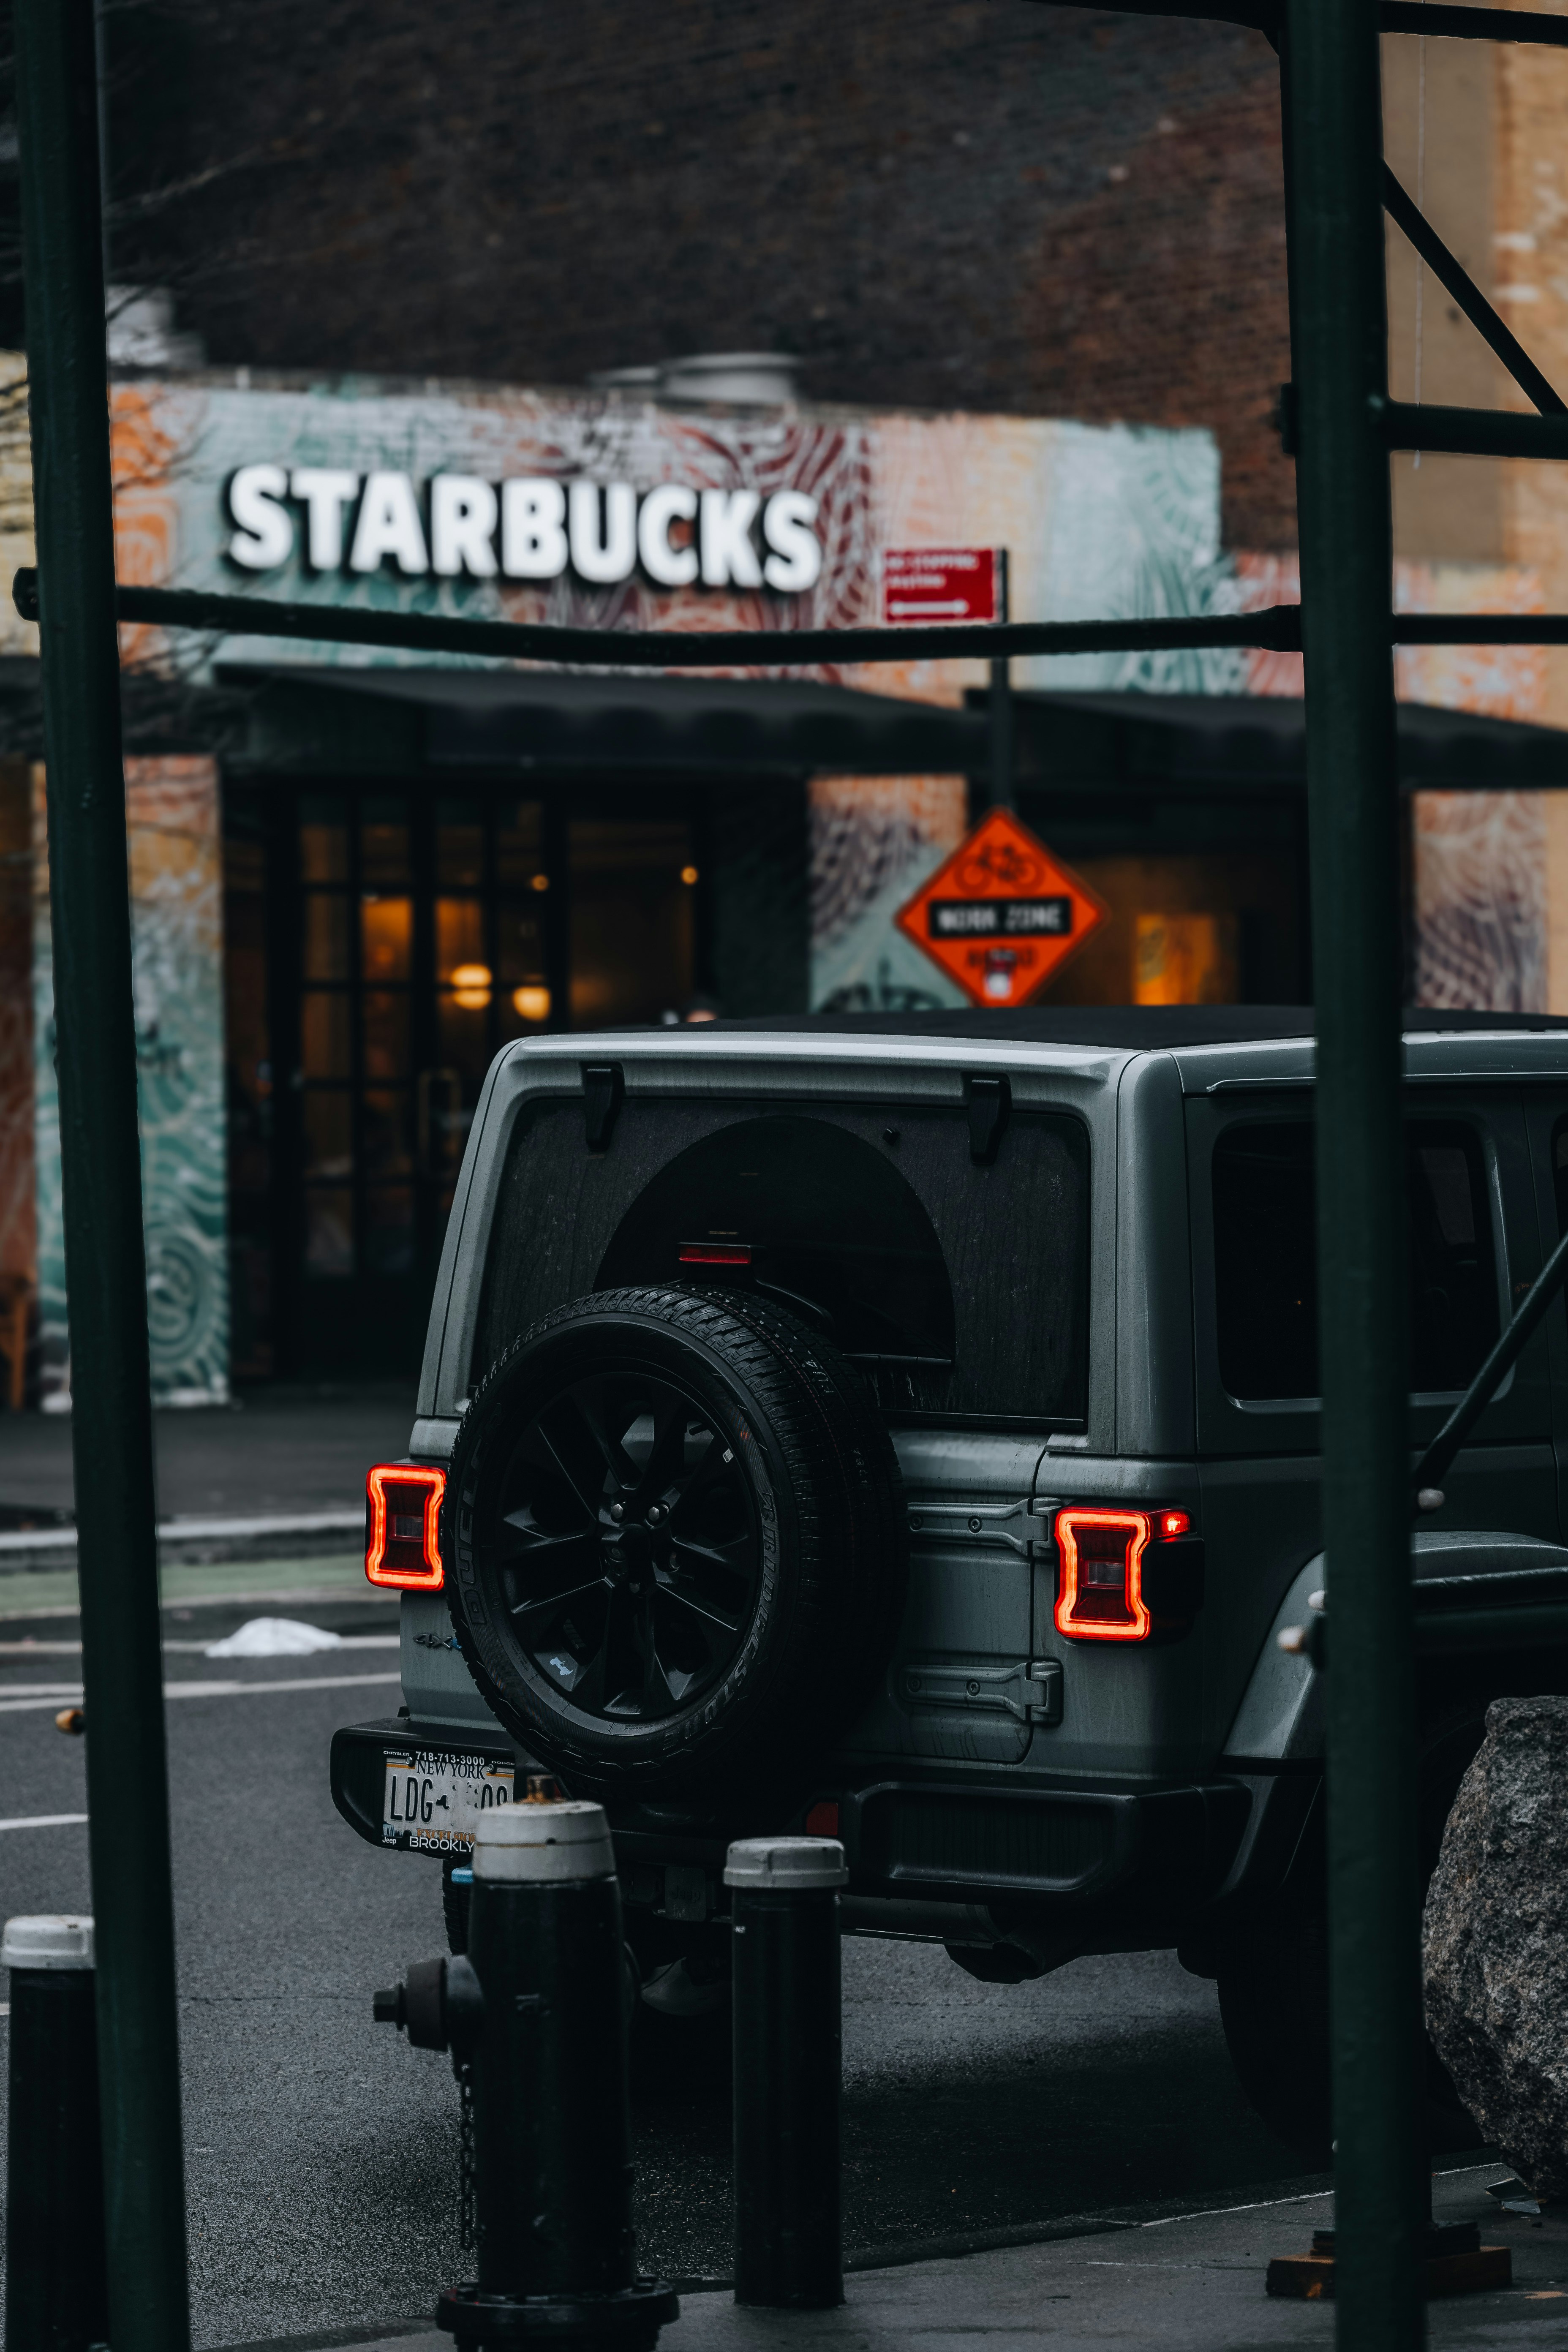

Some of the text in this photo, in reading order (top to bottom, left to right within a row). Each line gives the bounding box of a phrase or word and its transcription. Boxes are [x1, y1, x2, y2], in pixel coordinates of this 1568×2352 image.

[229, 465, 821, 591] STARBUCKS
[663, 1492, 778, 1750] BRIDGESTONE
[413, 1633, 462, 1650] 4x
[416, 1751, 485, 1766] 718-713-3000
[416, 1760, 486, 1780] NEW YORK
[390, 1775, 433, 1823] LDG
[382, 1836, 397, 1845] Jeep
[409, 1836, 475, 1852] BROOKLY
[416, 1828, 476, 1843] EXCELSIO
